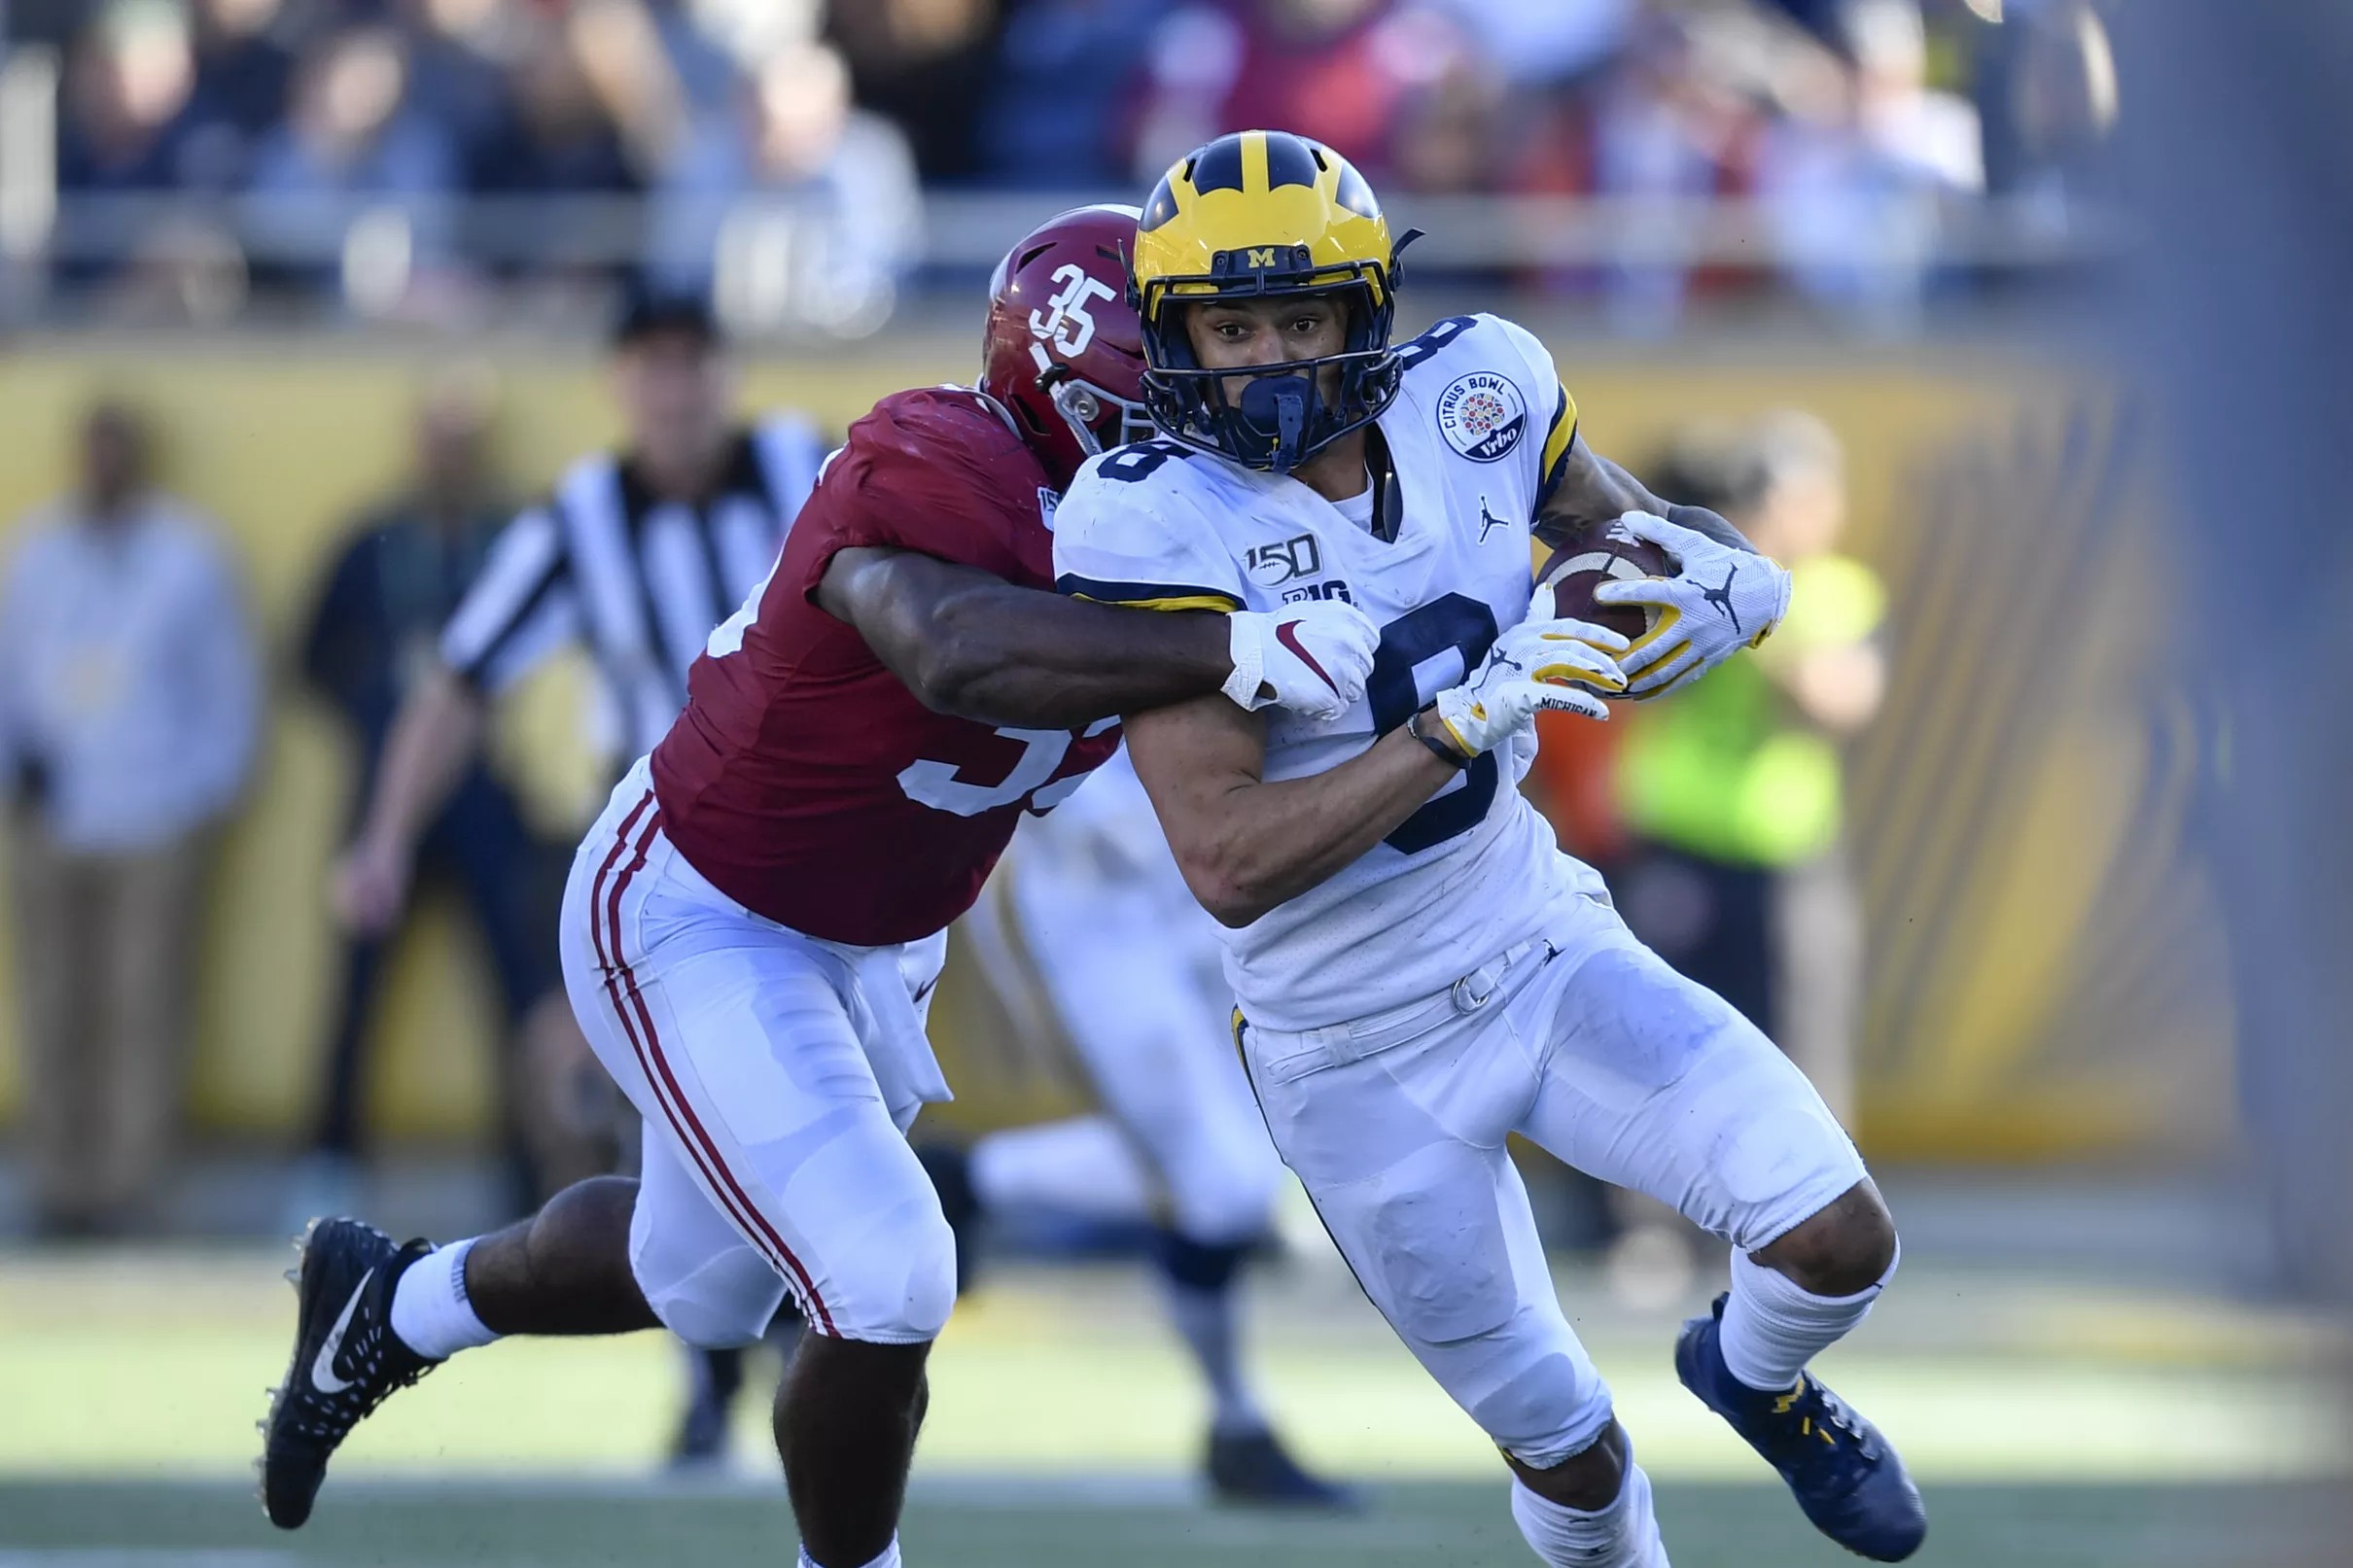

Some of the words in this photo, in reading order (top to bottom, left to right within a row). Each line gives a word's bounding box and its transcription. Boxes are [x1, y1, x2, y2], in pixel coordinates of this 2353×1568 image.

[1247, 248, 1276, 268] M
[1029, 263, 1117, 358] 35
[1443, 385, 1465, 429] CITRUS
[1468, 377, 1505, 395] BOWL
[1480, 428, 1517, 457] Vrbo
[1040, 490, 1061, 511] 15
[1244, 534, 1320, 586] 150
